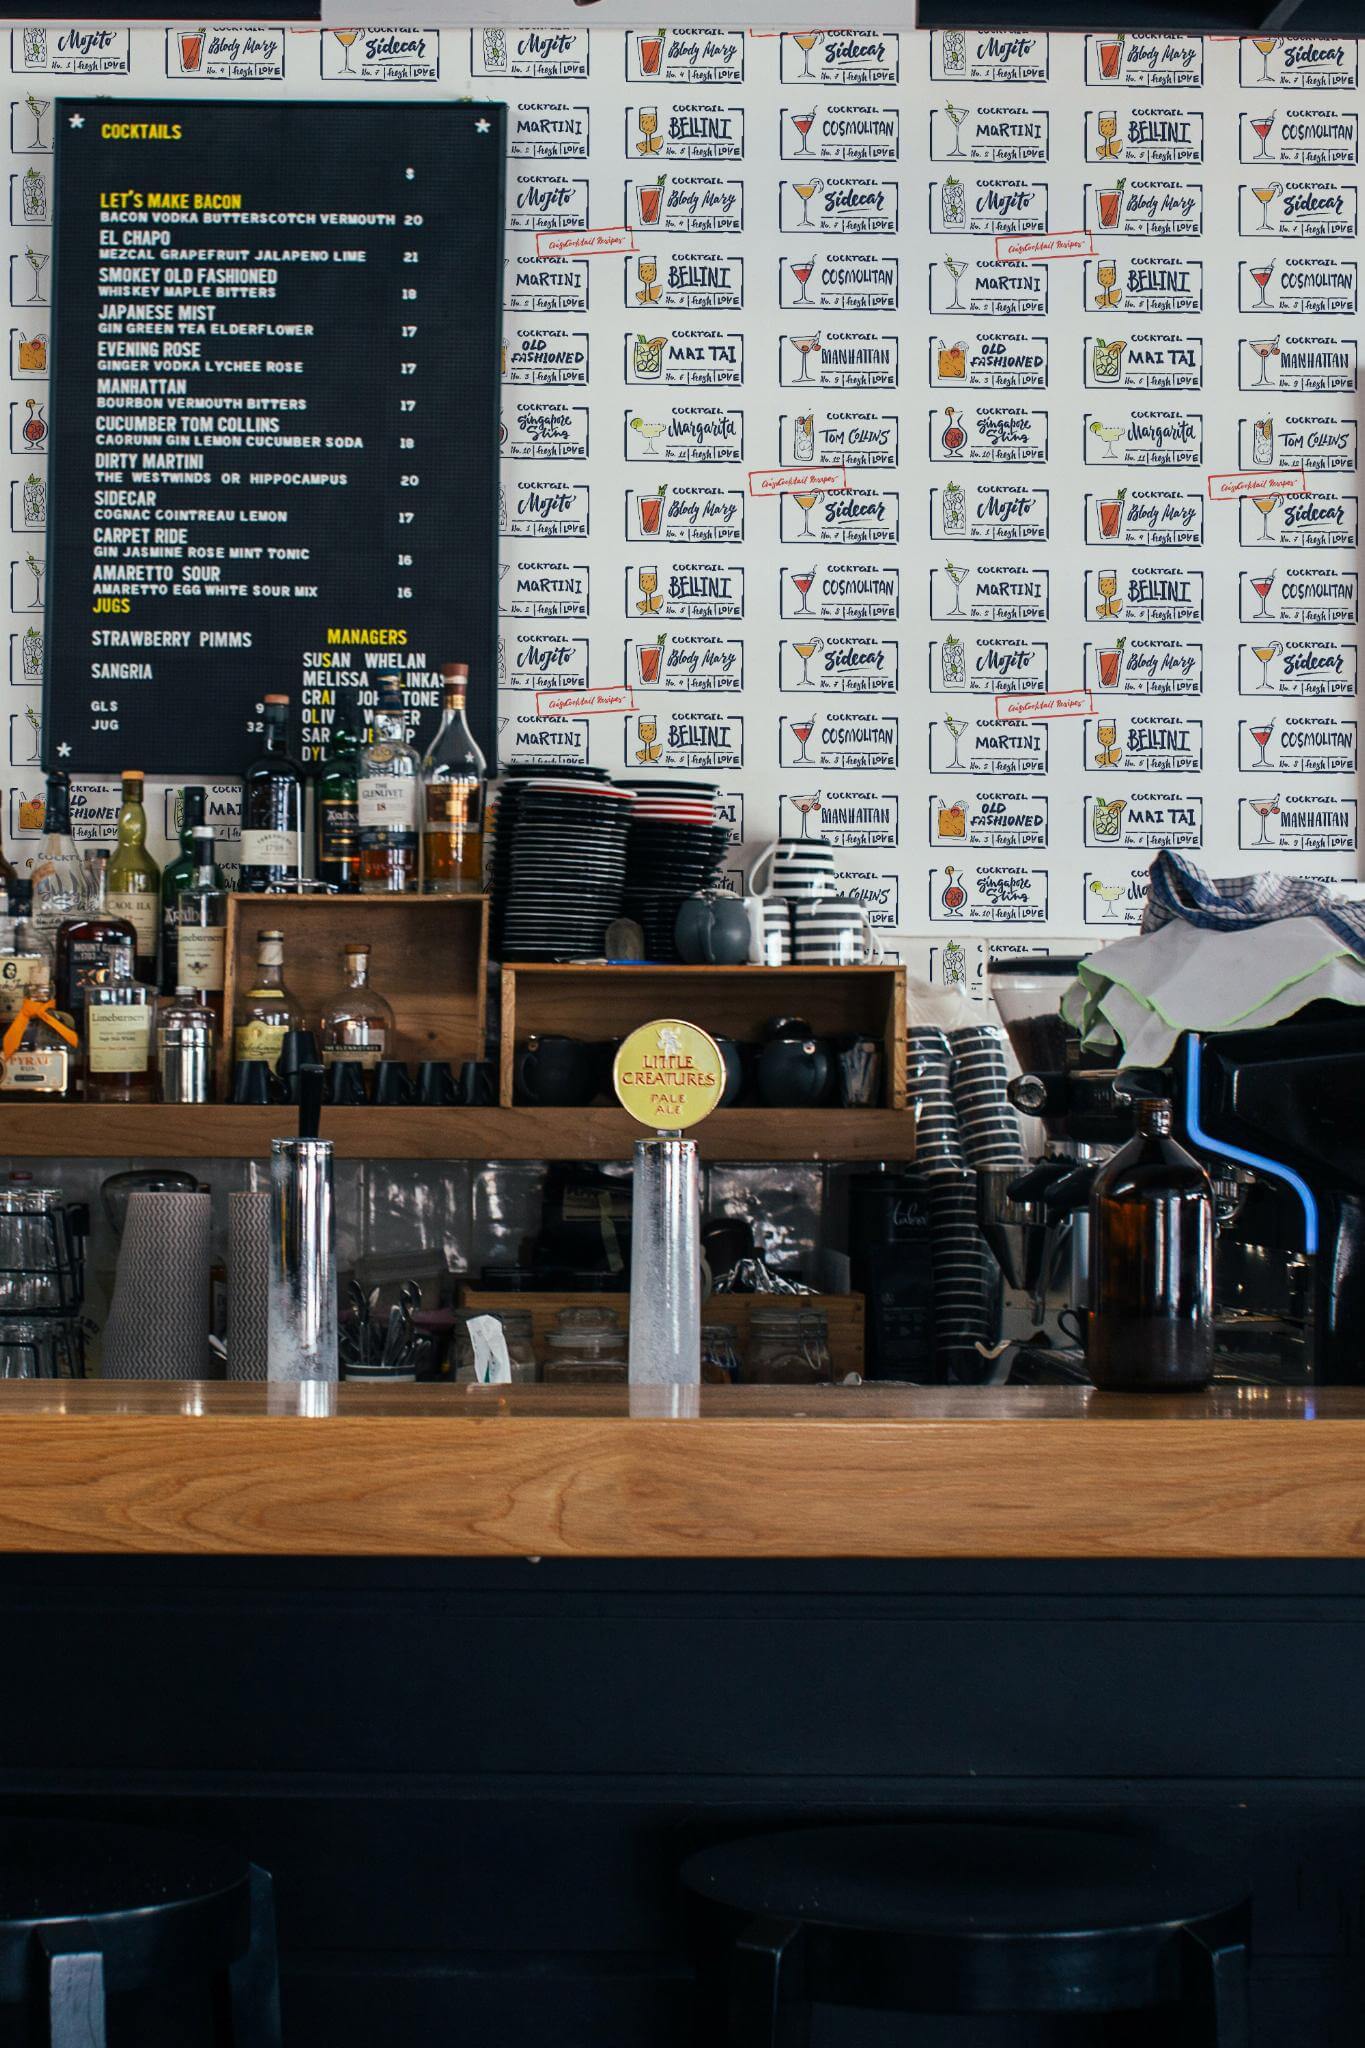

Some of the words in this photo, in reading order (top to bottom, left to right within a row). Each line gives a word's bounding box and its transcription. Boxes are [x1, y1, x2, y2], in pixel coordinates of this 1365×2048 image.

[58, 28, 117, 55] Mojito
[517, 33, 577, 59] Mojito
[102, 124, 182, 139] COCKTAILS
[668, 117, 732, 140] BELLINI
[1127, 120, 1192, 144] BELLINI
[718, 147, 740, 156] LOVE
[100, 190, 143, 208] LET'S
[148, 193, 189, 208] MAKE
[194, 194, 241, 209] BACON
[100, 212, 148, 223] BACON
[152, 212, 198, 223] VODKA
[203, 212, 316, 224] BUTTERSCOTCH
[320, 213, 395, 225] VERMOUTH
[404, 215, 423, 226] 20
[100, 230, 119, 245] EL
[123, 230, 170, 246] CHAPO
[99, 248, 155, 260] MEZCAL
[160, 249, 250, 261] GRAPEFRUIT
[254, 250, 329, 261] JALAPENO
[333, 251, 366, 262] LIME
[404, 252, 418, 262] 21
[99, 267, 160, 283] SMOKEY
[164, 268, 193, 283] OLD
[197, 268, 277, 284] FASHIONED
[98, 286, 160, 297] WHISKEY
[164, 286, 211, 297] MAPLE
[216, 287, 276, 298] BITTERS
[403, 289, 416, 299] 18
[98, 304, 173, 320] JAPANESE
[178, 305, 216, 321] MIST
[98, 323, 122, 333] GIN
[126, 323, 173, 334] GREEN
[178, 323, 206, 334] TEA
[211, 323, 313, 336] ELDERFLOWER
[402, 326, 417, 337] 17
[672, 330, 723, 338] COCKTAIL
[98, 341, 159, 357] EVENING
[163, 342, 201, 357] ROSE
[522, 339, 547, 351] OLD
[669, 346, 705, 360] MAI
[708, 346, 736, 363] TAI
[97, 360, 149, 371] GINGER
[154, 360, 200, 371] VODKA
[205, 361, 261, 372] LYCHEE
[266, 361, 303, 373] ROSE
[401, 363, 416, 374] 17
[718, 373, 740, 382] LOVE
[97, 378, 186, 394] MANHATTAN
[97, 397, 163, 408] BOURBON
[167, 398, 242, 409] VERMOUTH
[247, 398, 306, 410] BITTERS
[401, 400, 416, 411] 17
[96, 416, 177, 432] CUCUMBER
[181, 416, 213, 432] TOM
[218, 417, 279, 433] COLLINS
[96, 434, 162, 446] CAORUNN
[166, 435, 190, 446] GIN
[194, 435, 242, 447] LEMON
[246, 436, 321, 447] CUCUMBER
[326, 437, 363, 448] SODA
[400, 438, 414, 449] 18
[95, 453, 138, 469] DIRTY
[143, 453, 203, 469] MARTINI
[95, 471, 123, 483] THE
[132, 472, 211, 483] WESTWINDS
[221, 473, 240, 484] OR
[250, 473, 347, 485] HIPPOCAMPUS
[401, 475, 419, 486] 20
[95, 490, 156, 506] SIDECAR
[94, 509, 150, 520] COGNAC
[155, 509, 235, 521] COINTREAU
[240, 510, 287, 522] LEMON
[399, 512, 414, 523] 17
[977, 496, 1036, 522] Mojito
[94, 527, 150, 544] CARPET
[155, 528, 187, 544] RIDE
[94, 546, 118, 557] GIN
[123, 546, 182, 558] JASMINE
[188, 547, 225, 558] ROSE
[229, 548, 263, 559] MINT
[267, 548, 309, 560] TONIC
[398, 554, 412, 565] 16
[93, 565, 173, 581] AMARETTO
[182, 566, 220, 581] SOUR
[977, 566, 1029, 574] COCKTAIL
[93, 584, 168, 595] AMARETTO
[173, 584, 201, 595] EGG
[205, 585, 248, 596] WHITE
[253, 585, 290, 597] SOUR
[295, 586, 317, 597] MIX
[398, 587, 412, 598] 16
[1127, 580, 1192, 603] BELLINI
[93, 598, 130, 613] JUGS
[1022, 609, 1045, 619] LOVE
[92, 630, 191, 647] STRAWBERRY
[200, 631, 252, 647] PIMMS
[328, 629, 407, 645] MANAGERS
[303, 652, 351, 668] SUSAN
[365, 653, 426, 669] WHELAN
[92, 663, 153, 679] SANGRIA
[303, 671, 369, 687] MELISSA
[302, 690, 336, 706] CRAI
[91, 701, 118, 712] GLS
[256, 703, 264, 714] 9
[91, 719, 119, 730] JUG
[247, 722, 264, 732] 32
[362, 789, 402, 798] GLENLIVET
[982, 802, 1006, 814] OLD
[1128, 809, 1164, 823] MAI
[1167, 809, 1196, 826] TAI
[642, 1056, 694, 1069] LITTLE
[622, 1072, 715, 1086] CREATURES
[651, 1094, 686, 1104] PALE
[656, 1106, 680, 1114] ALE
